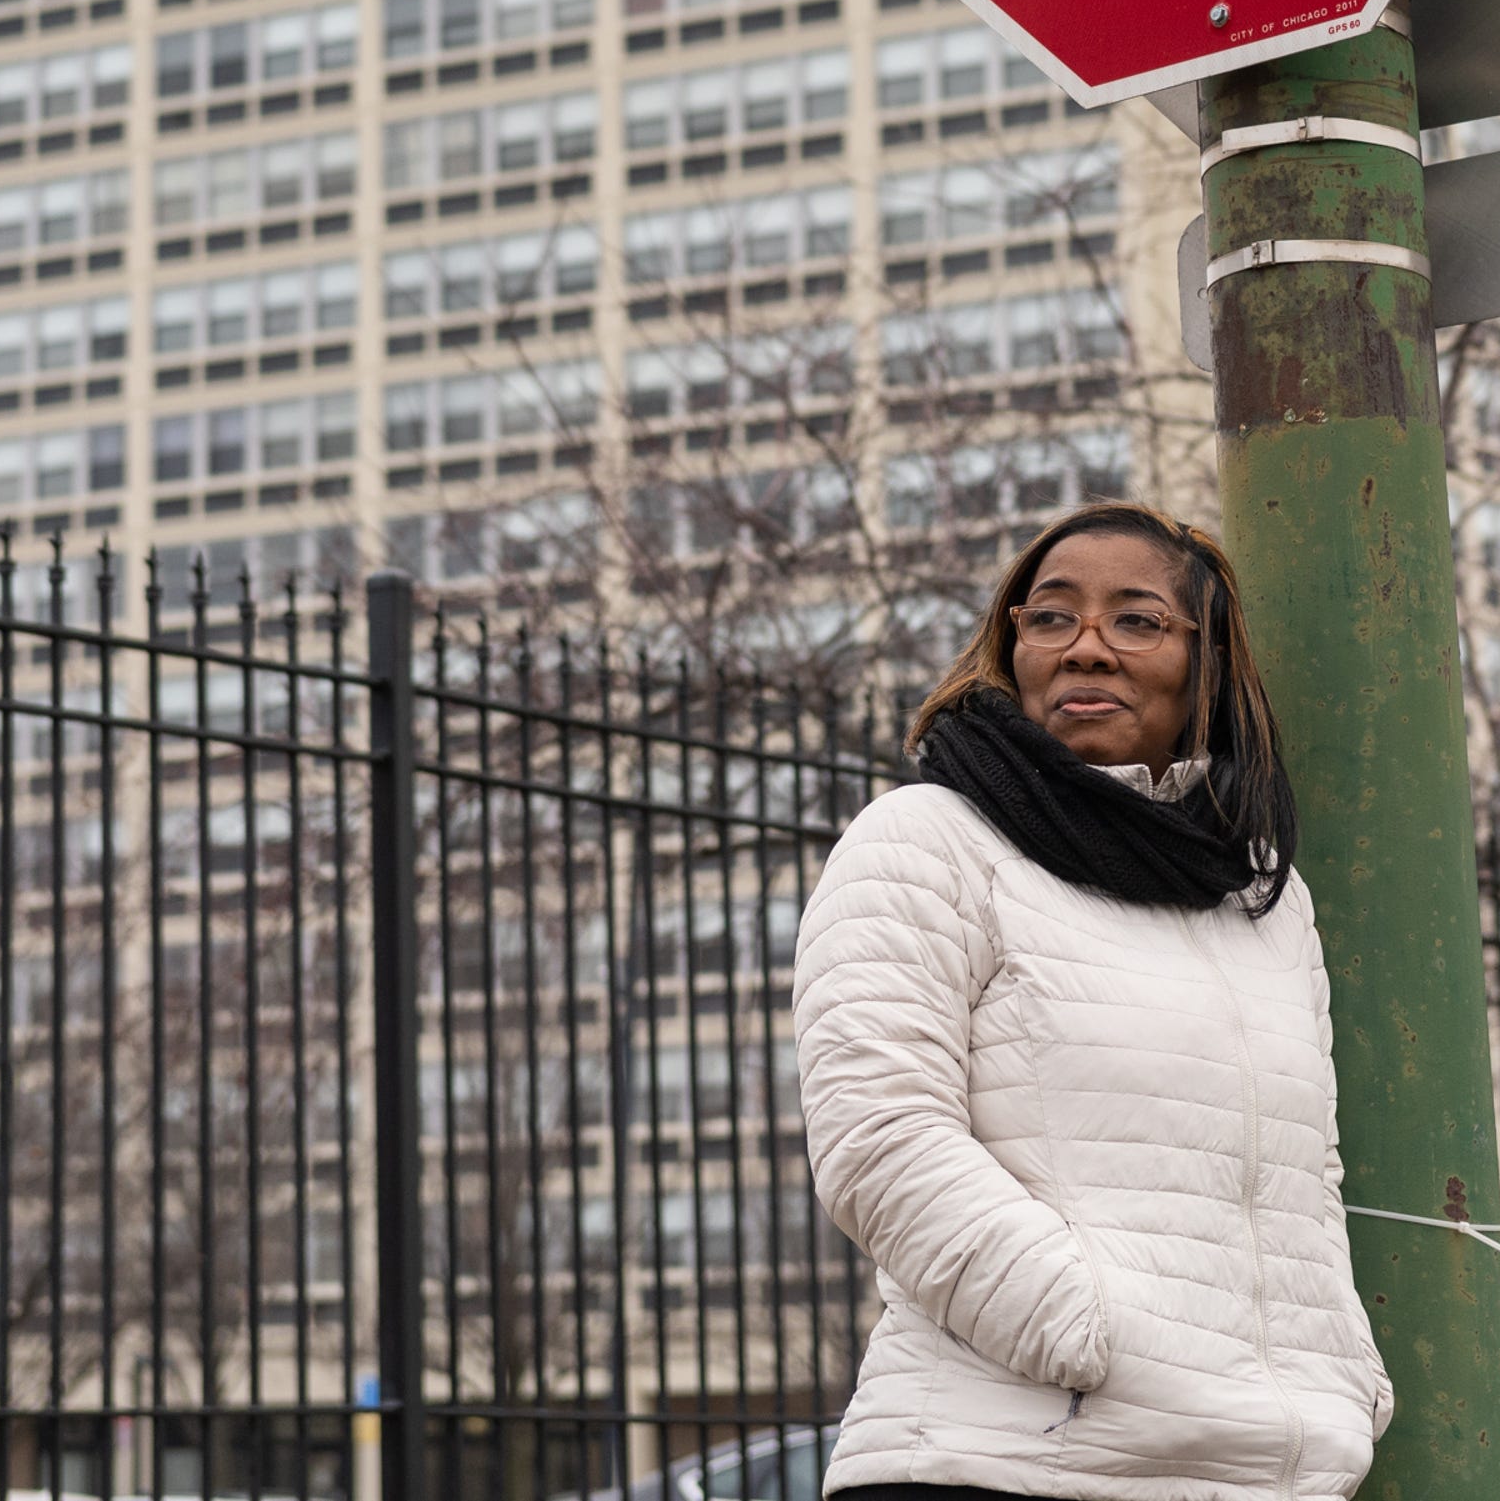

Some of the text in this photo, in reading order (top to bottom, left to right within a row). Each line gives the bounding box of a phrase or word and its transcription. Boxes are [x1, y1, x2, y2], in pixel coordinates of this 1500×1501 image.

[1230, 0, 1358, 42] CITY OF CHICAGO 2011
[1328, 23, 1348, 35] GPS
